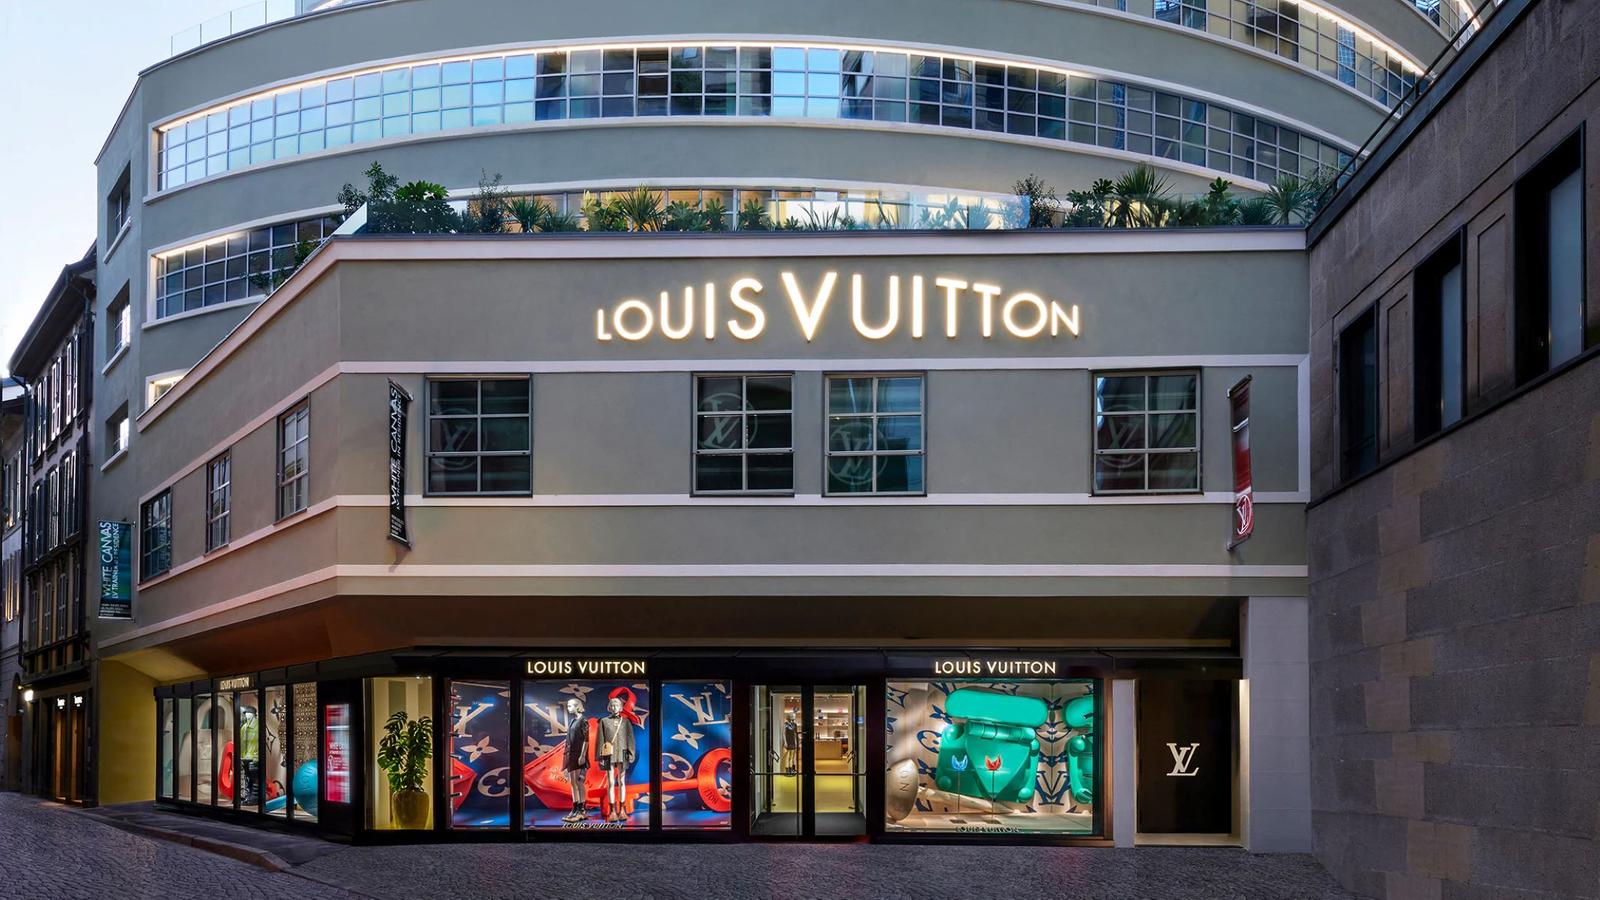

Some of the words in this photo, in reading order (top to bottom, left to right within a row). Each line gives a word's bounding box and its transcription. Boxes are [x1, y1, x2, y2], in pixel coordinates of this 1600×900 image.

[597, 278, 766, 341] LOUIS
[781, 271, 1080, 342] VUITTON
[390, 387, 399, 453] CANVAS
[390, 457, 398, 506] WHITE
[100, 522, 113, 562] CANVAS
[102, 566, 112, 596] WHITE
[112, 591, 119, 599] LV
[527, 661, 573, 675] LOUIS
[577, 661, 646, 675] VUITTON
[934, 661, 982, 675] LOUIS
[986, 661, 1057, 675] VUITTON
